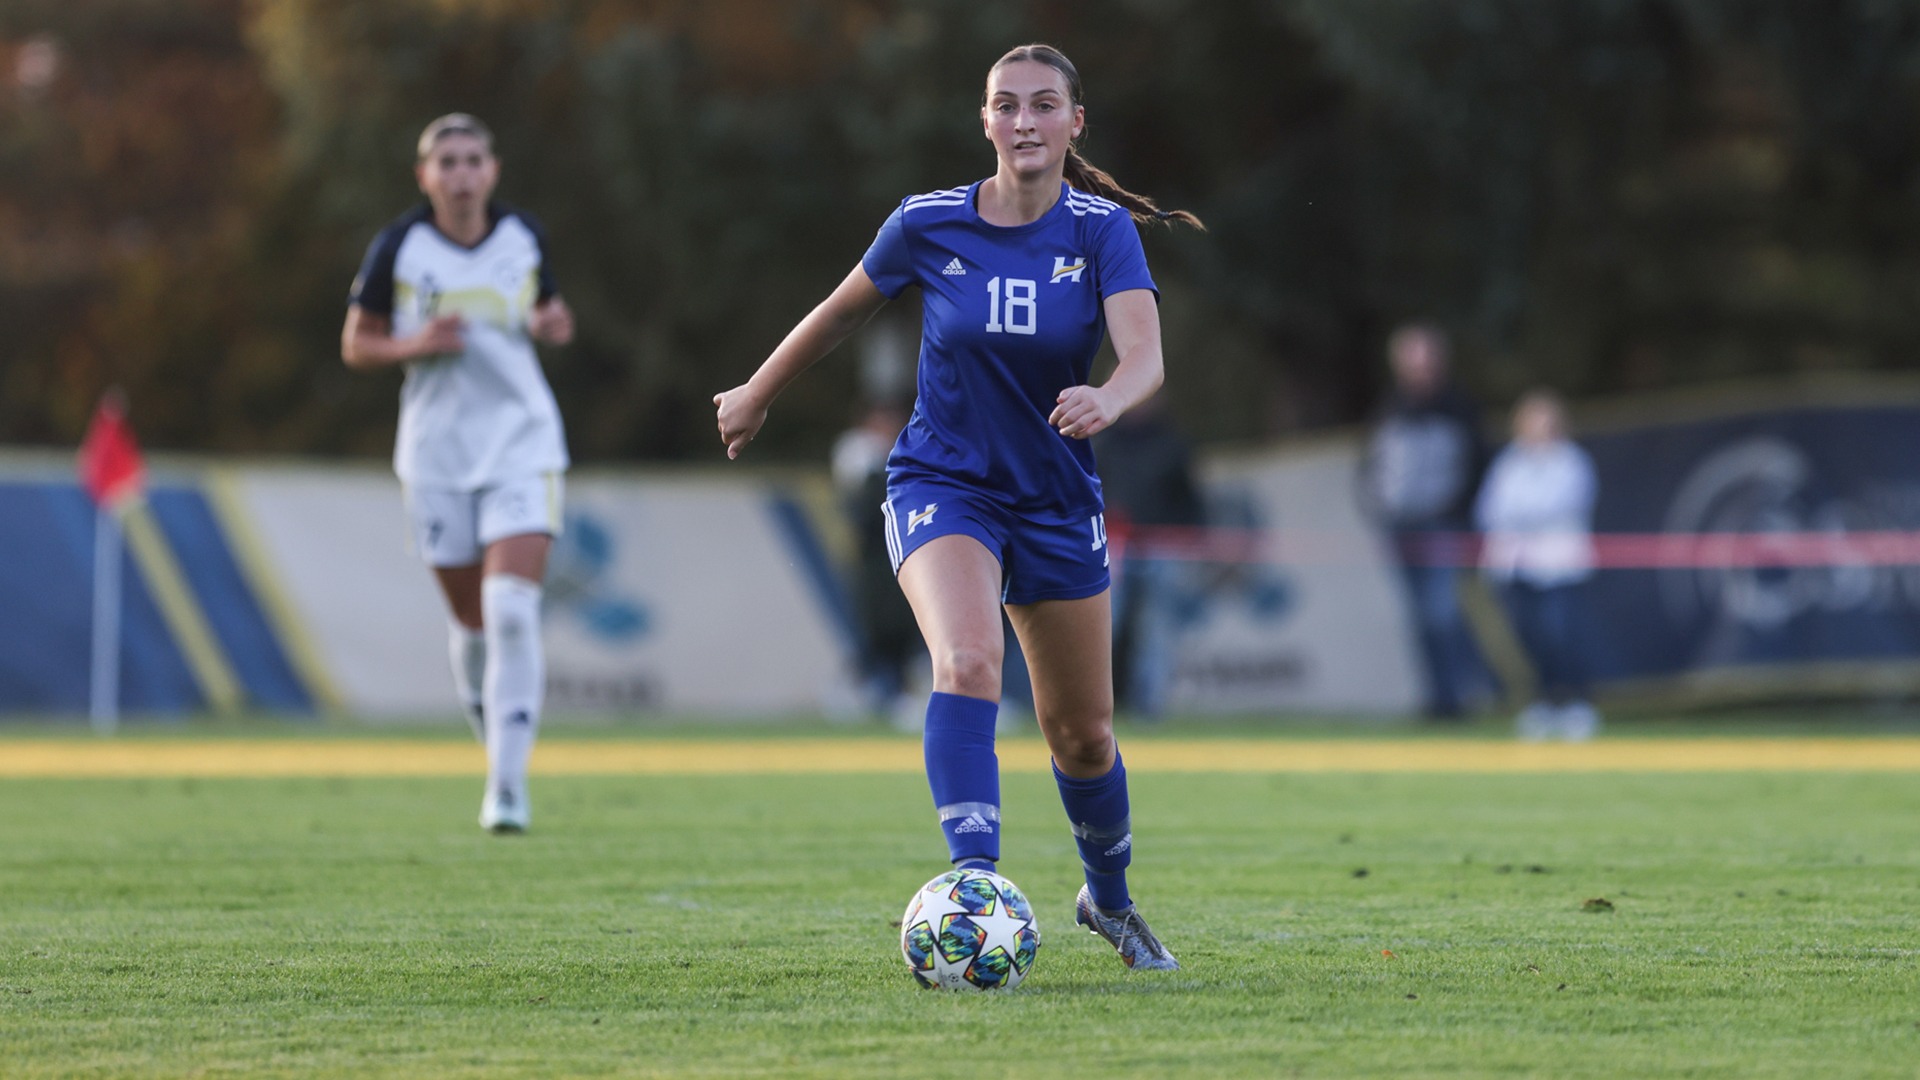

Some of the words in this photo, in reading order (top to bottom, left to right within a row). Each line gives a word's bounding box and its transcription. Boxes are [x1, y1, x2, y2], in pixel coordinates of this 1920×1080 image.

[942, 268, 966, 276] adidas
[986, 276, 1036, 335] 18
[955, 825, 993, 834] adidas
